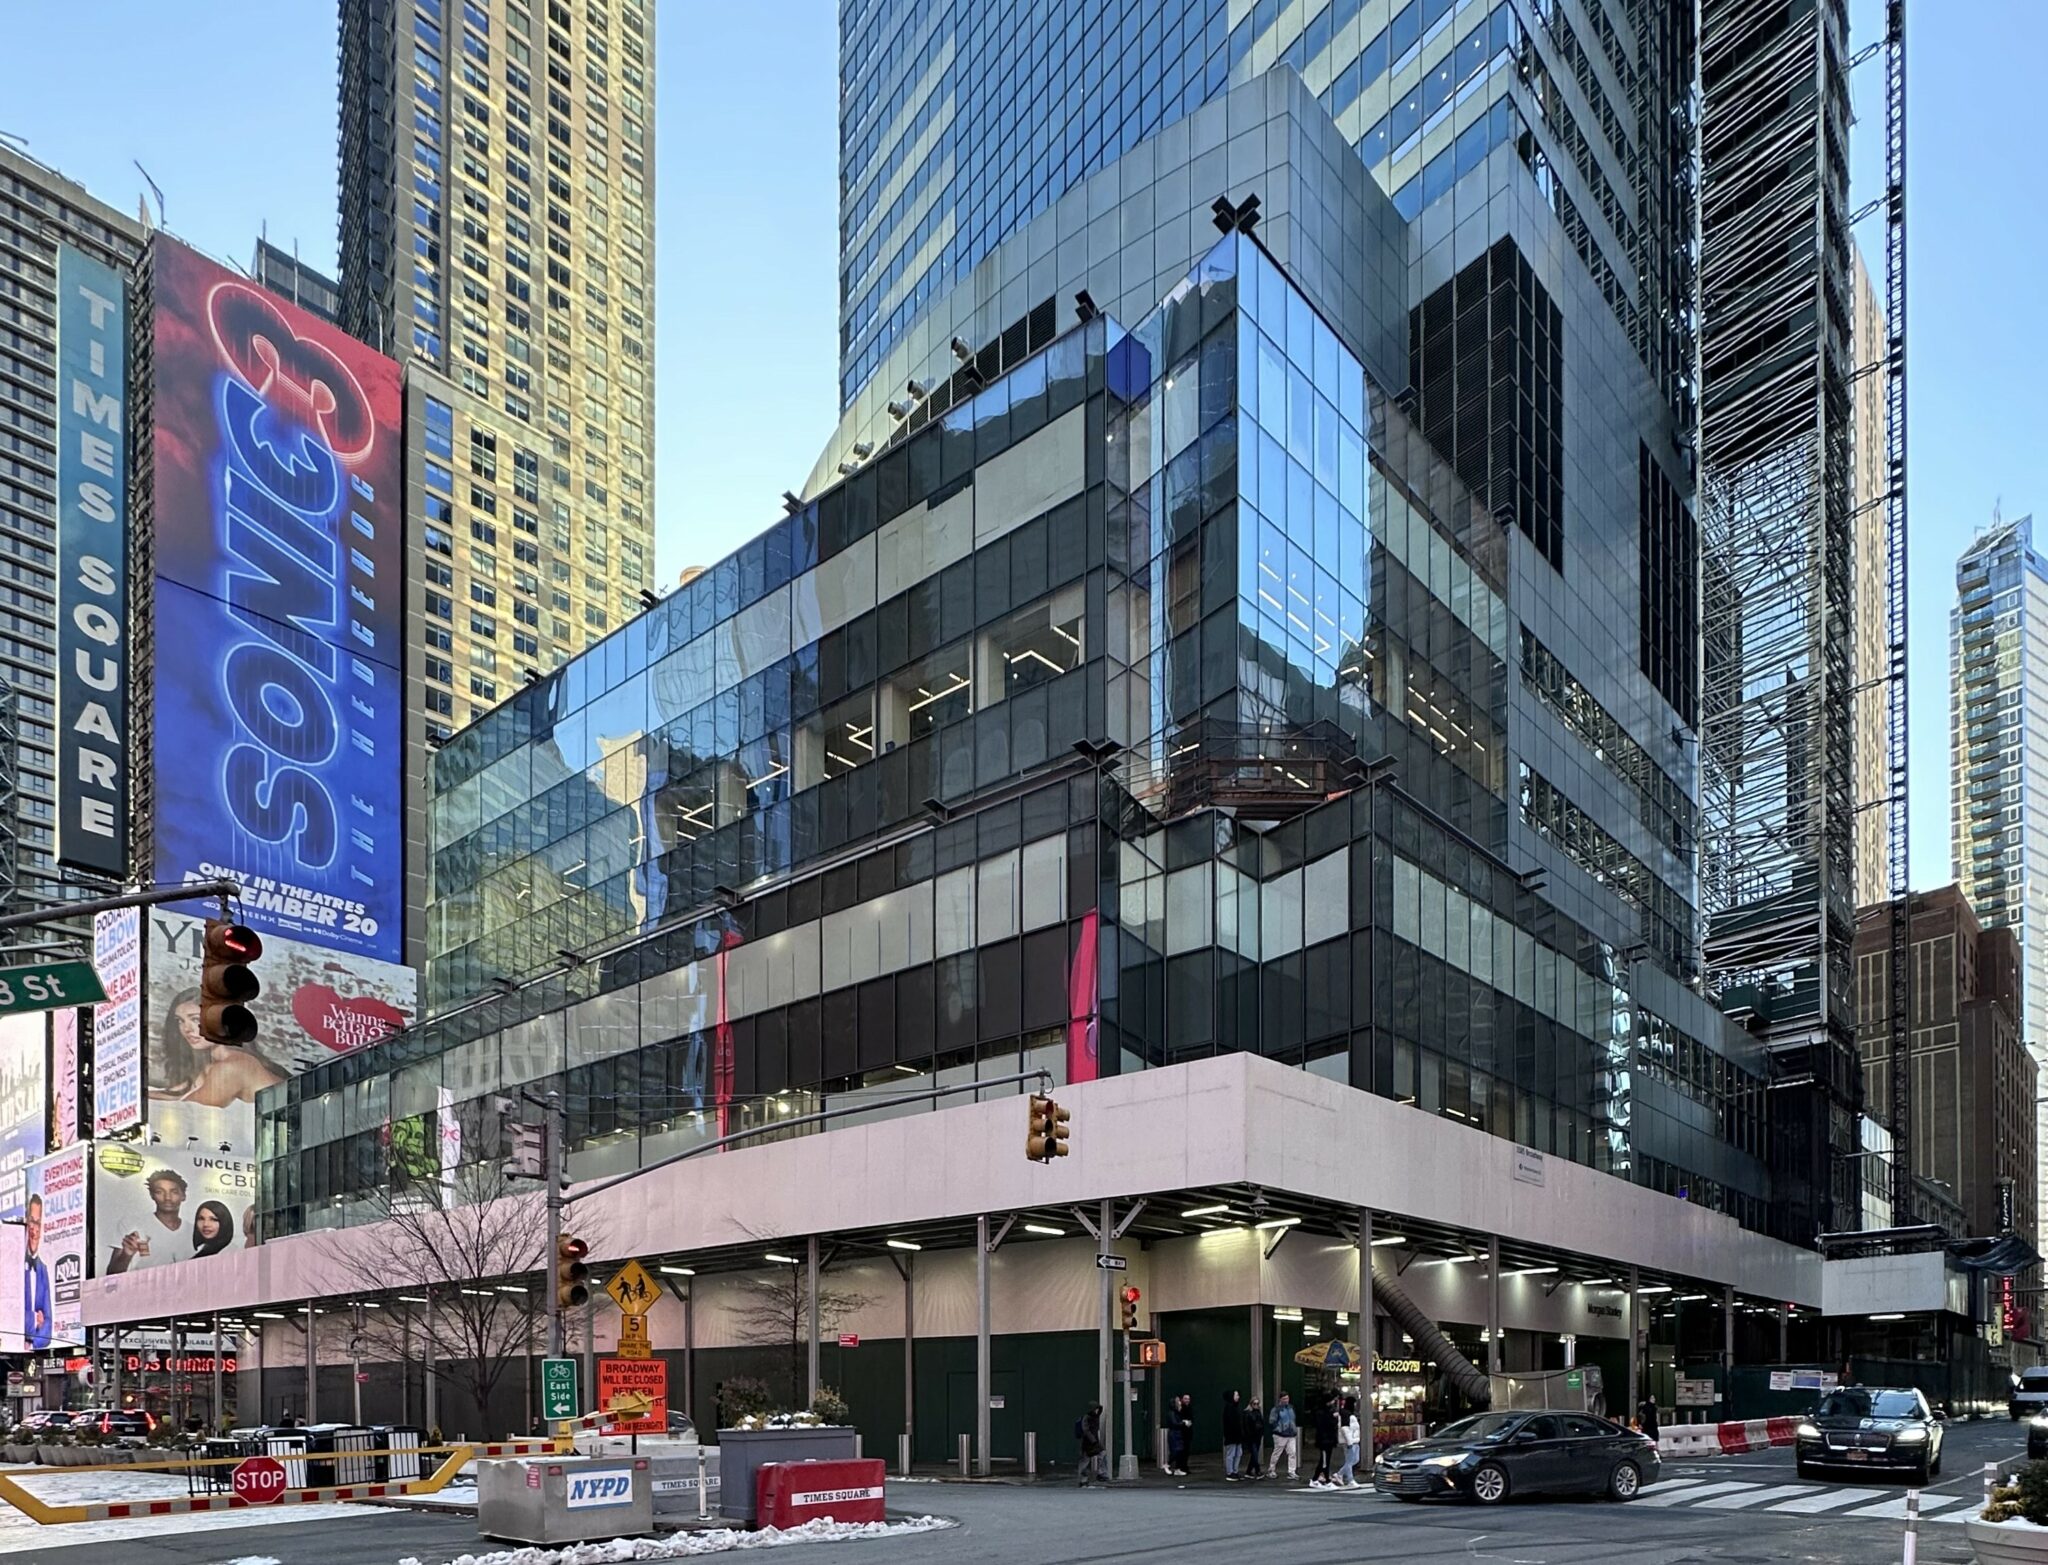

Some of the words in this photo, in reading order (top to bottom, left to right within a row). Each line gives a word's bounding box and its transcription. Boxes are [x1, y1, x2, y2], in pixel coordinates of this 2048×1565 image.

[207, 282, 375, 466] 3
[73, 286, 121, 524] TIMES
[222, 377, 339, 871] SONIC
[351, 472, 375, 758] HEDGEHOG
[73, 555, 121, 839] SQUARE
[351, 794, 375, 888] THE
[199, 862, 246, 885] ONLY
[254, 876, 276, 892] IN
[279, 882, 366, 916] THEATRES
[96, 911, 138, 959] ELBOW
[343, 912, 379, 937] 20
[22, 973, 66, 1001] St
[119, 966, 138, 991] DAY
[96, 1012, 116, 1035] KNEE
[329, 1003, 389, 1029] Wanna
[96, 1075, 138, 1116] WE'RE
[44, 1156, 84, 1183] EVERYTHING
[193, 1157, 241, 1171] UNCLE
[44, 1193, 66, 1218] CALL
[629, 1317, 640, 1332] 5
[602, 1374, 621, 1385] WILL
[622, 1374, 633, 1384] BE
[633, 1374, 664, 1385] CLOSED
[605, 1363, 660, 1374] BROADWAY
[550, 1381, 570, 1390] East
[551, 1391, 571, 1401] Side
[236, 1470, 284, 1490] STOP
[570, 1476, 630, 1500] NYPD
[661, 1480, 687, 1490] TIMES
[803, 1493, 834, 1503] TIMES
[835, 1489, 871, 1500] SQUARE
